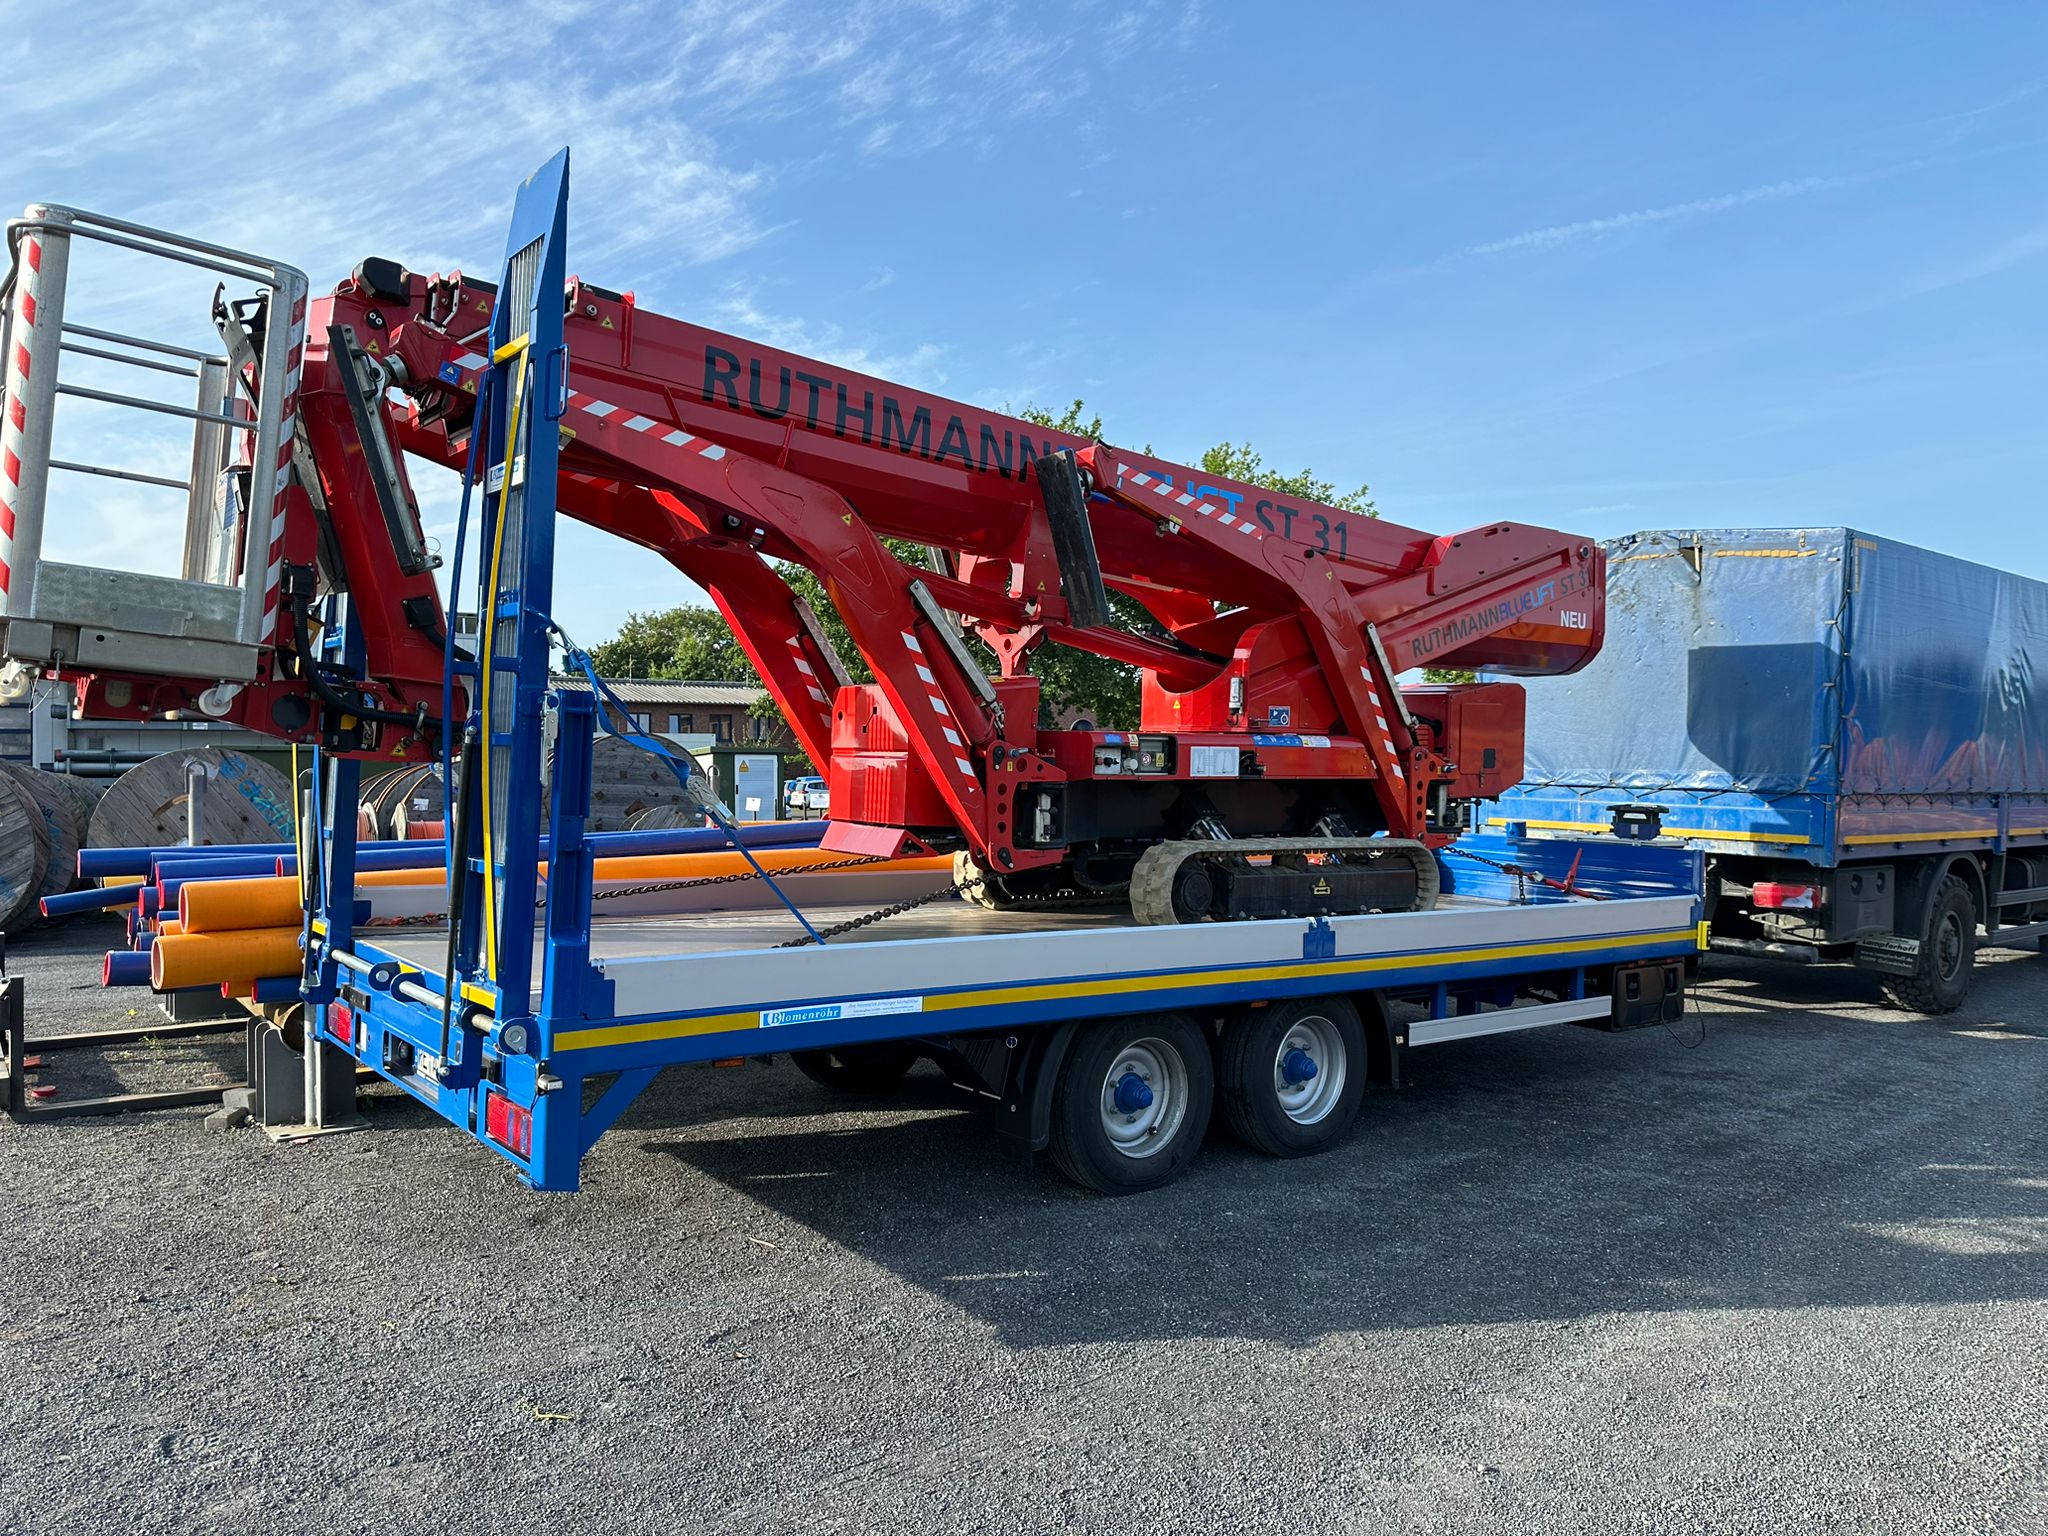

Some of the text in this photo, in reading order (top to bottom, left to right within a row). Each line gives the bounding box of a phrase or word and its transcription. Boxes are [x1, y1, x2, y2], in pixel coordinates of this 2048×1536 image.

[702, 344, 1051, 483] RUTHMANN
[1255, 500, 1347, 561] ST 31
[1560, 573, 1575, 595] ST
[1560, 610, 1587, 629] NEU
[1862, 939, 1917, 953] Lampferhoff
[770, 1007, 839, 1025] Blomenröhr
